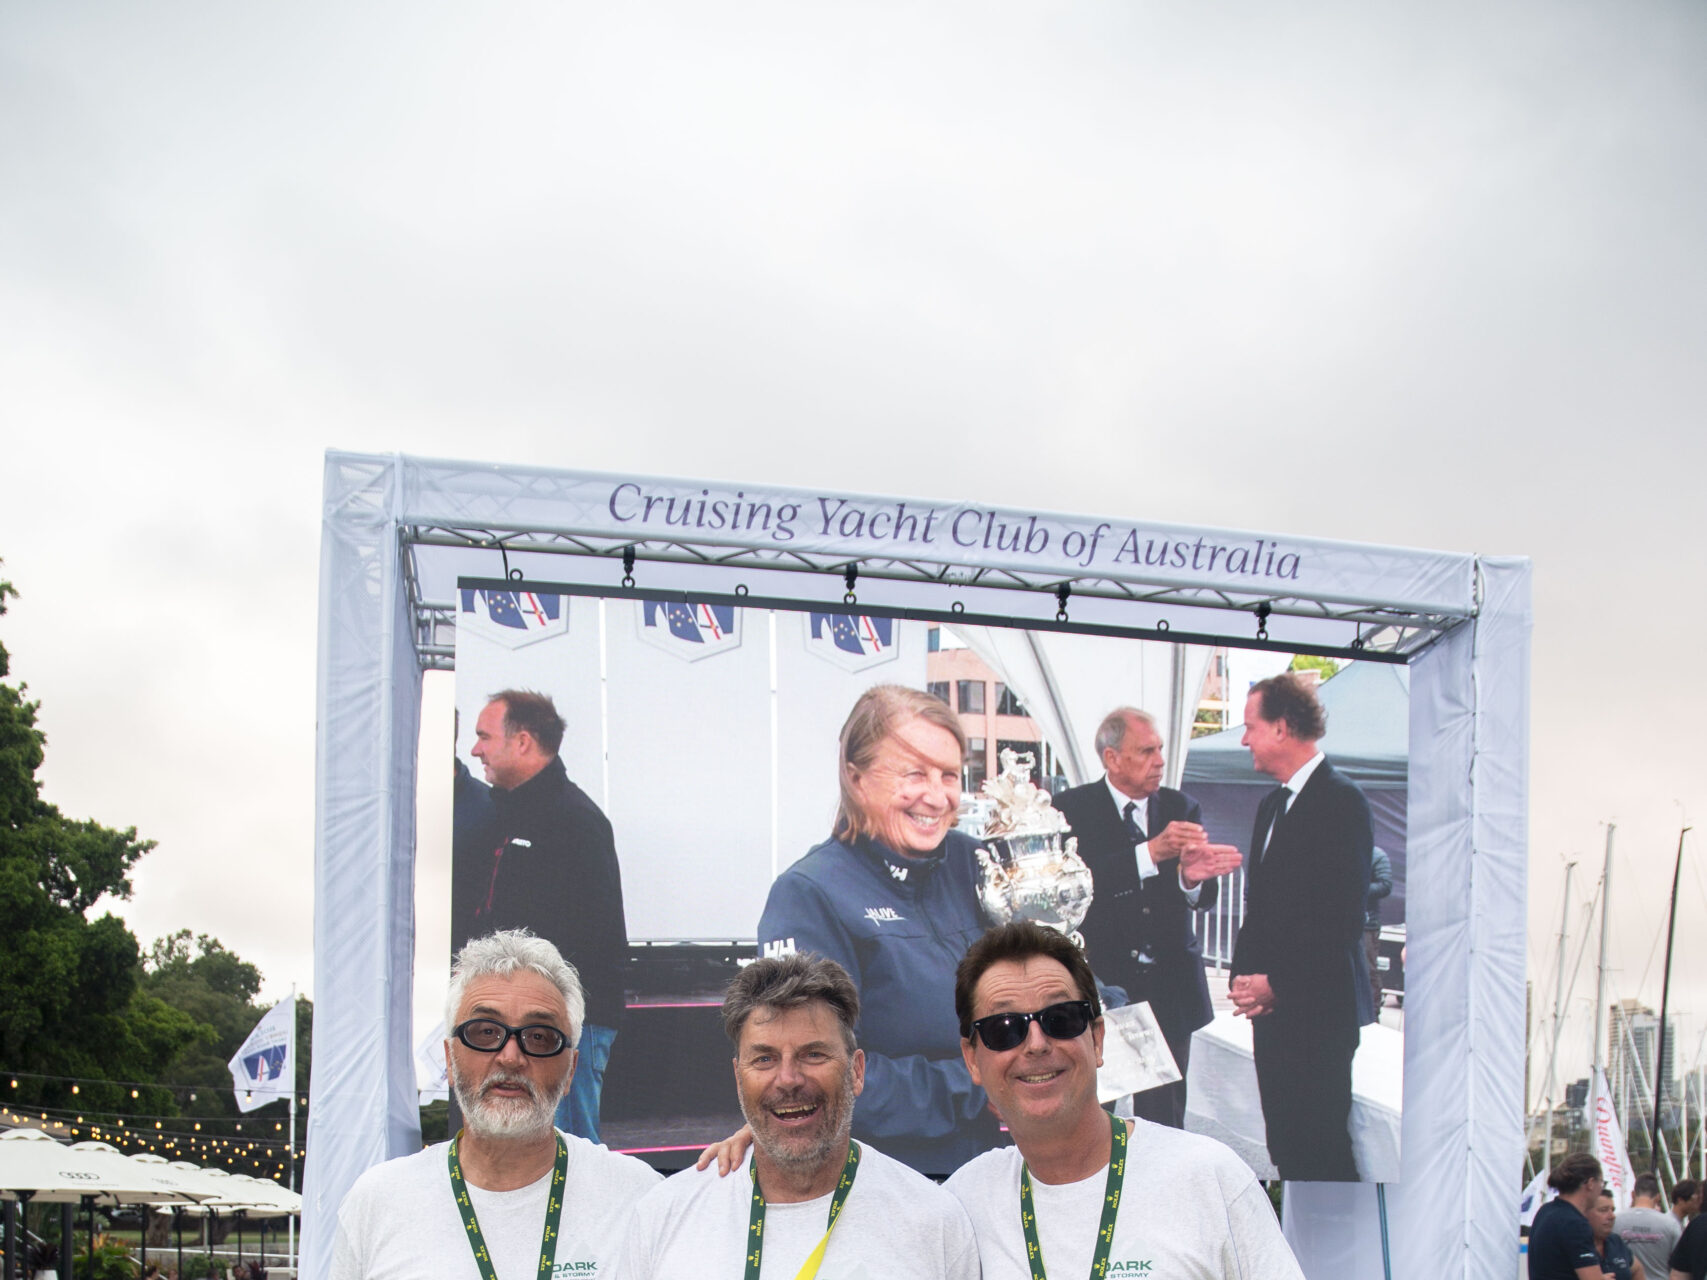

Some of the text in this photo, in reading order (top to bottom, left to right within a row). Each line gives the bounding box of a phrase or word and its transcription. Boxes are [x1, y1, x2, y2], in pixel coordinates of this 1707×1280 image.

[609, 483, 1300, 580] Cruising Yacht Club of Australia
[1105, 1223, 1113, 1243] ROLEX
[553, 1262, 597, 1272] DARK
[1098, 1257, 1106, 1277] ROLEX
